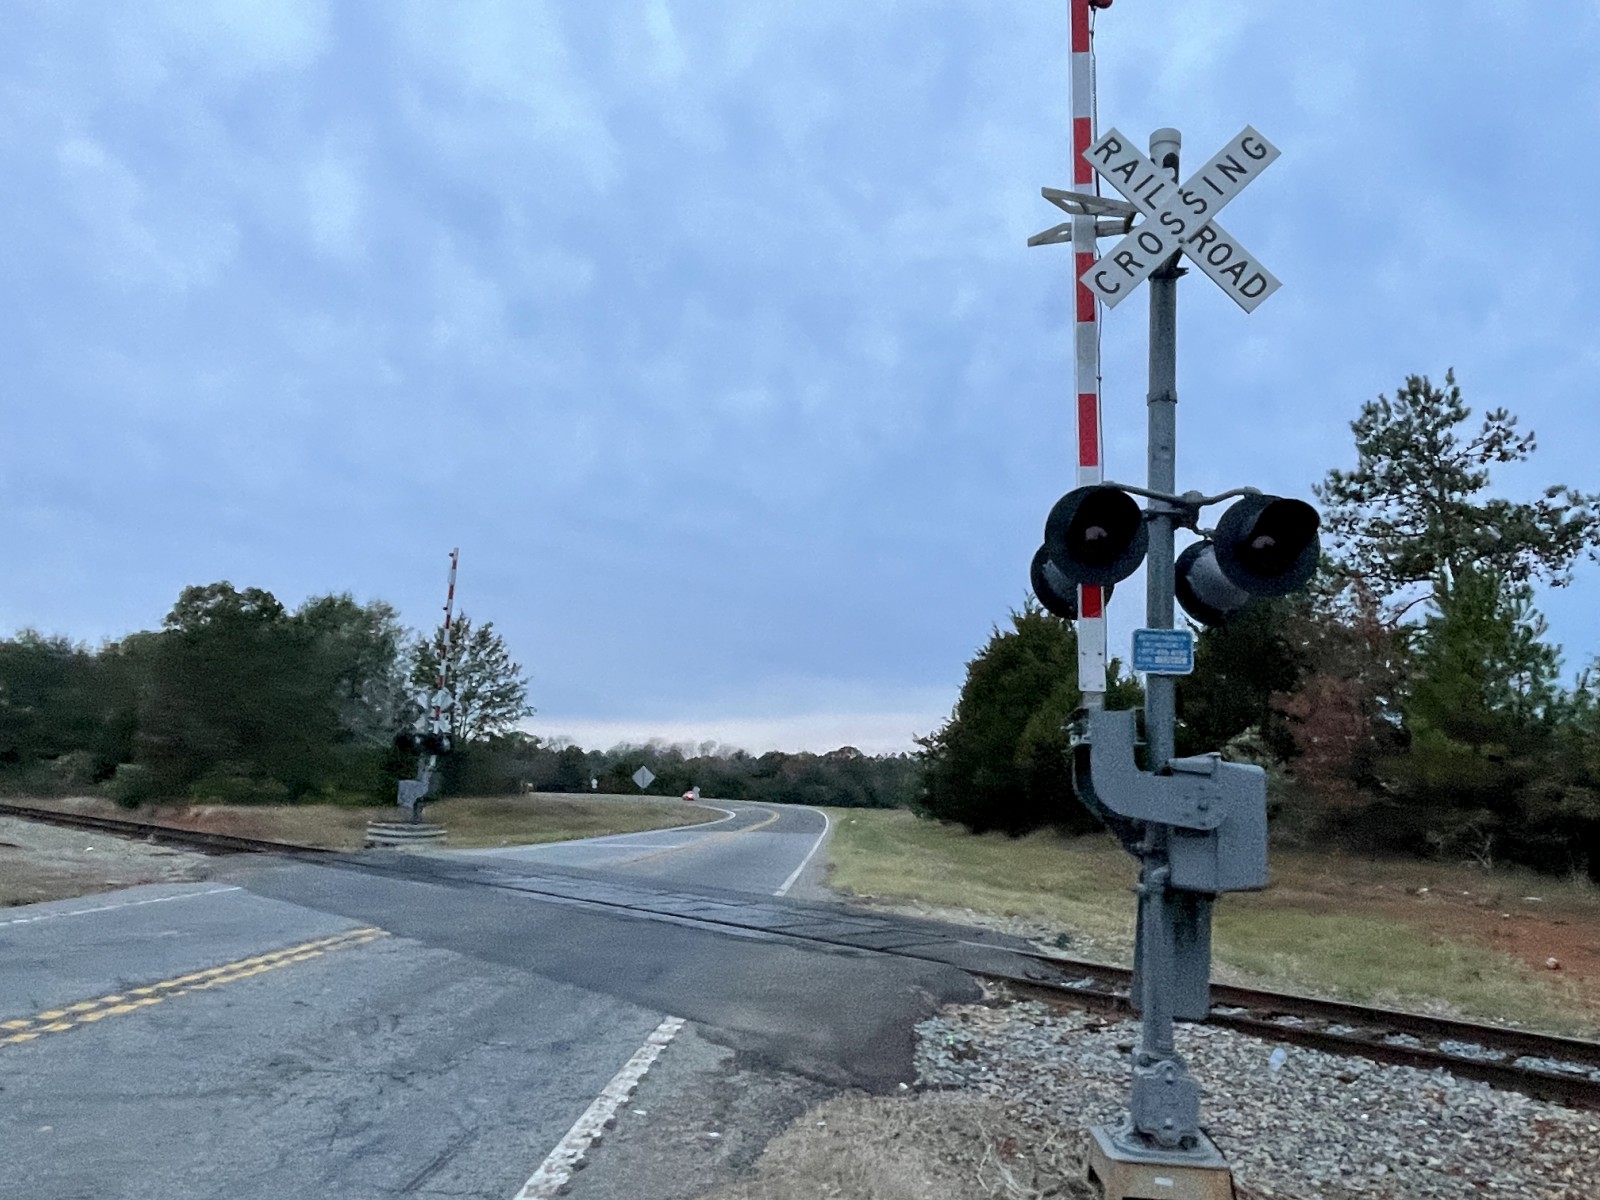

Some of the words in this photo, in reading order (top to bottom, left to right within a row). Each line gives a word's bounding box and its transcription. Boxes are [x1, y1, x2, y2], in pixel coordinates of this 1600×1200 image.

[1094, 136, 1267, 294] CROSSING
[1094, 136, 1165, 210] RAIL
[1188, 225, 1267, 298] ROAD
